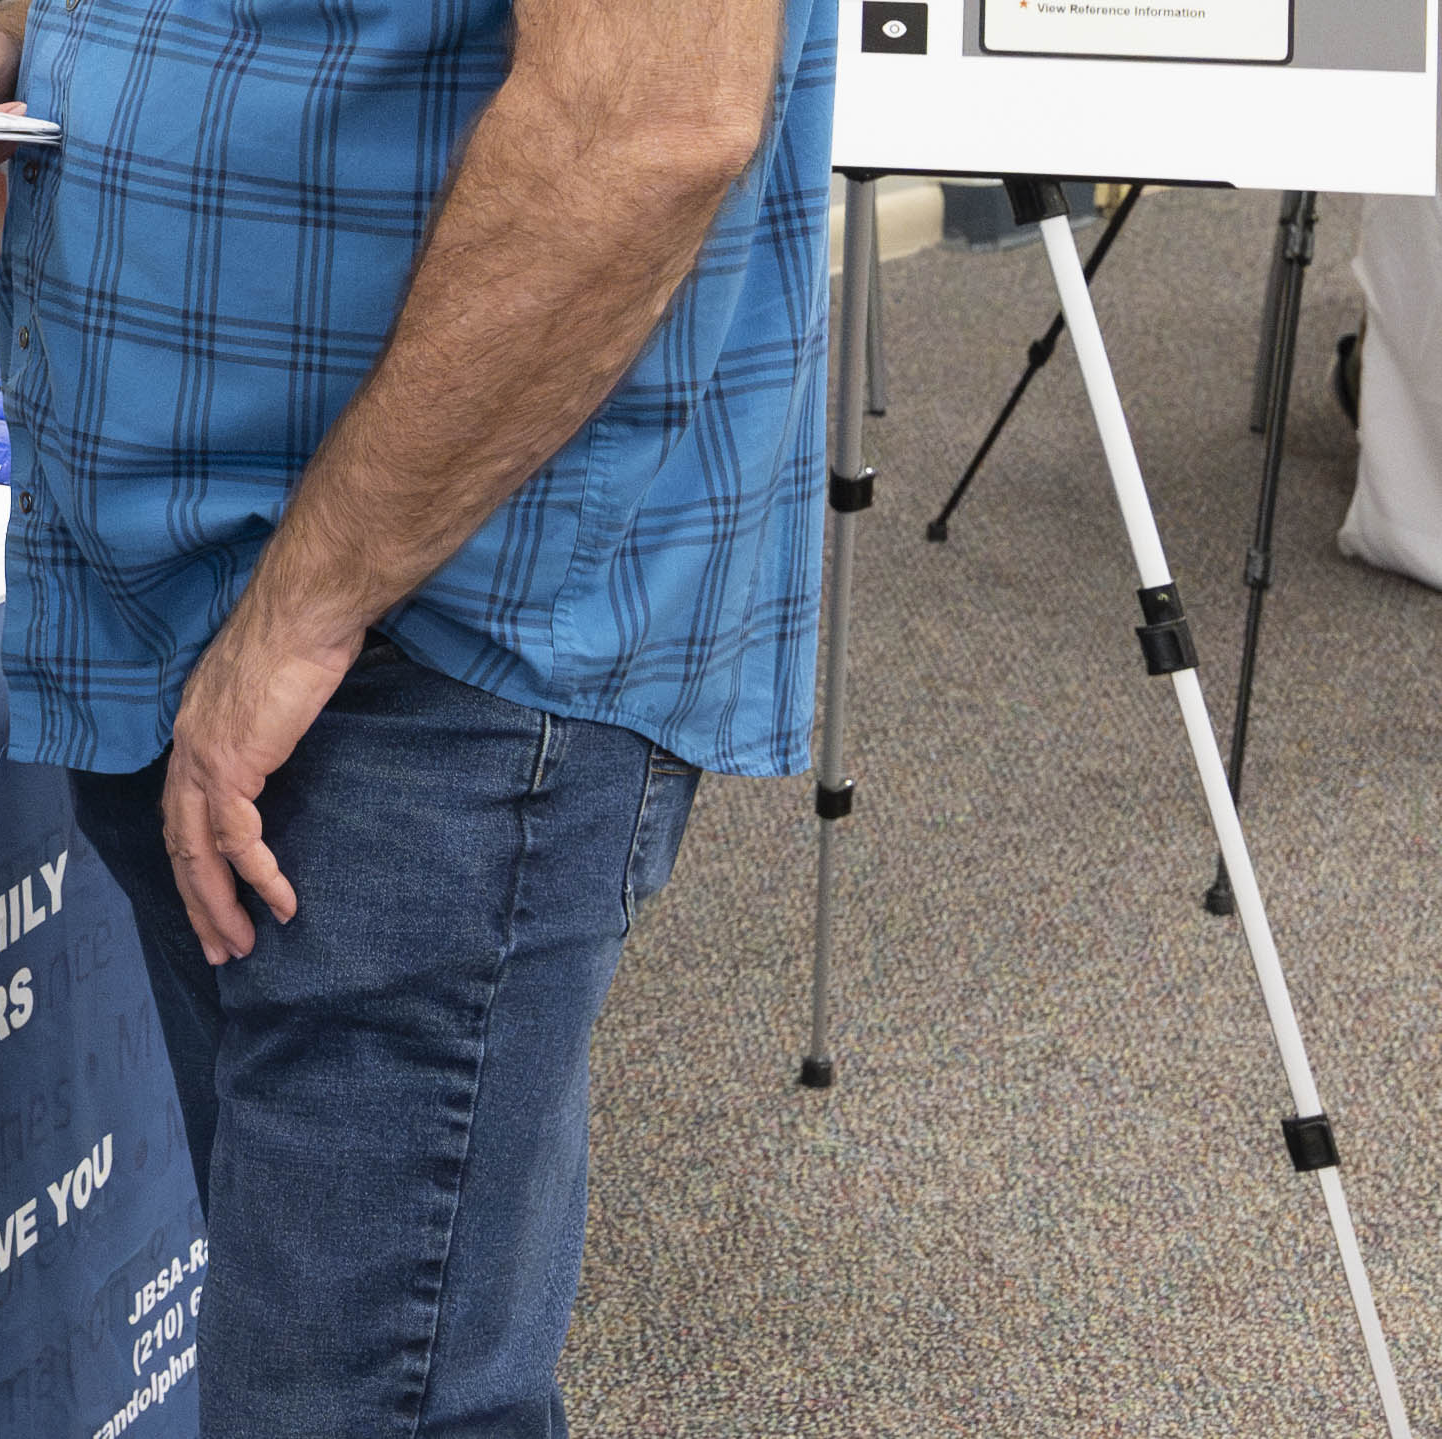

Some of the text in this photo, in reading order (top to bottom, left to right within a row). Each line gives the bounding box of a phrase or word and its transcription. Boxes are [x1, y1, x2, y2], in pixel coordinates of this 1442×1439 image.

[1037, 2, 1206, 19] View Reference Information
[47, 1132, 113, 1231] YOU
[133, 1286, 203, 1376] (210) 6
[92, 1343, 198, 1439] randolphm
